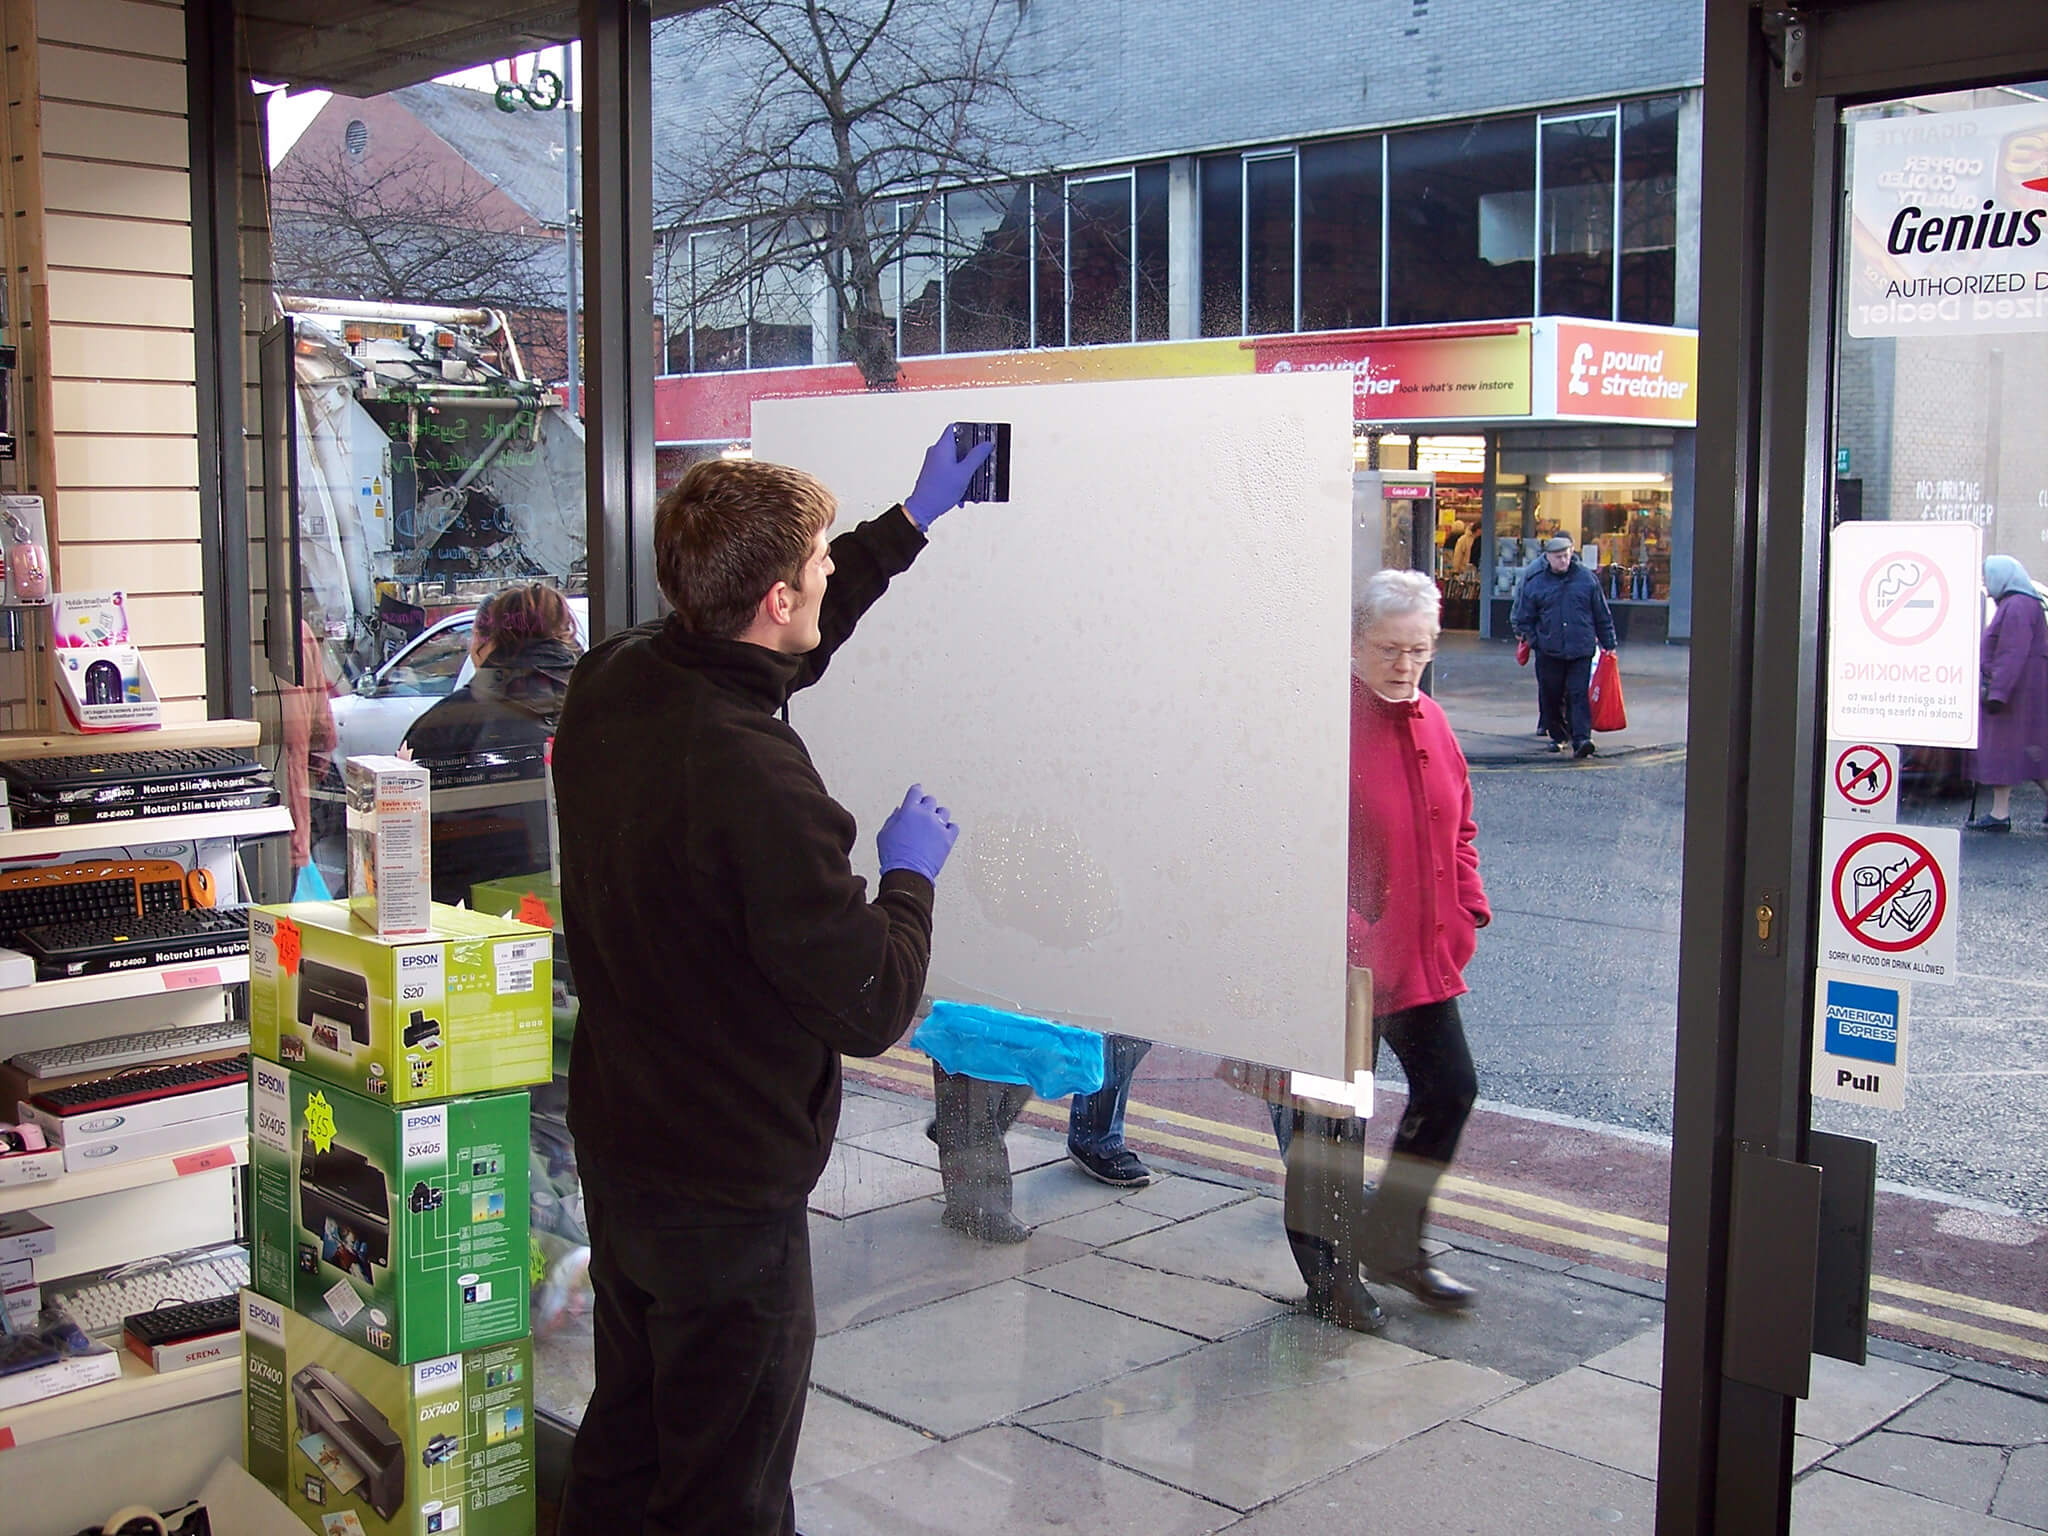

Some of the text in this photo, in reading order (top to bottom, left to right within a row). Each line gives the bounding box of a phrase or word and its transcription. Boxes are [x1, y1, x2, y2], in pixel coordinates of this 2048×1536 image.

[1887, 200, 2048, 256] Genius
[1886, 273, 2026, 299] AUTHORIZED
[1601, 349, 1664, 375] pound
[1400, 380, 1514, 394] look what's new instore
[1600, 373, 1689, 400] stretcher
[1916, 479, 1934, 500] NO
[68, 658, 79, 671] 3
[143, 781, 179, 795] Natural
[180, 779, 200, 791] Slim
[97, 809, 134, 820] KB-E4003
[143, 802, 180, 815] Natural
[182, 800, 203, 812] Slim
[204, 797, 250, 810] keyboard
[253, 919, 274, 935] EPSON
[109, 943, 250, 969] KB-E4003 Natural Slim keybo
[402, 954, 438, 967] EPSON
[1828, 950, 1945, 976] SORRY, NO FOOD OR DRINK ALLOWED
[403, 986, 424, 1000] S20
[1826, 1006, 1893, 1026] AMERICAN
[1840, 1023, 1896, 1041] EXPRESS
[258, 1071, 285, 1096] EPSON
[1837, 1069, 1880, 1093] Pull
[258, 1112, 286, 1137] SX405
[407, 1114, 441, 1128] EPSON
[408, 1143, 441, 1158] SX405
[249, 1303, 280, 1329] EPSON
[185, 1348, 221, 1362] SERENA
[249, 1359, 283, 1385] DX7400
[420, 1360, 458, 1380] EPSON
[419, 1400, 460, 1422] DX7400
